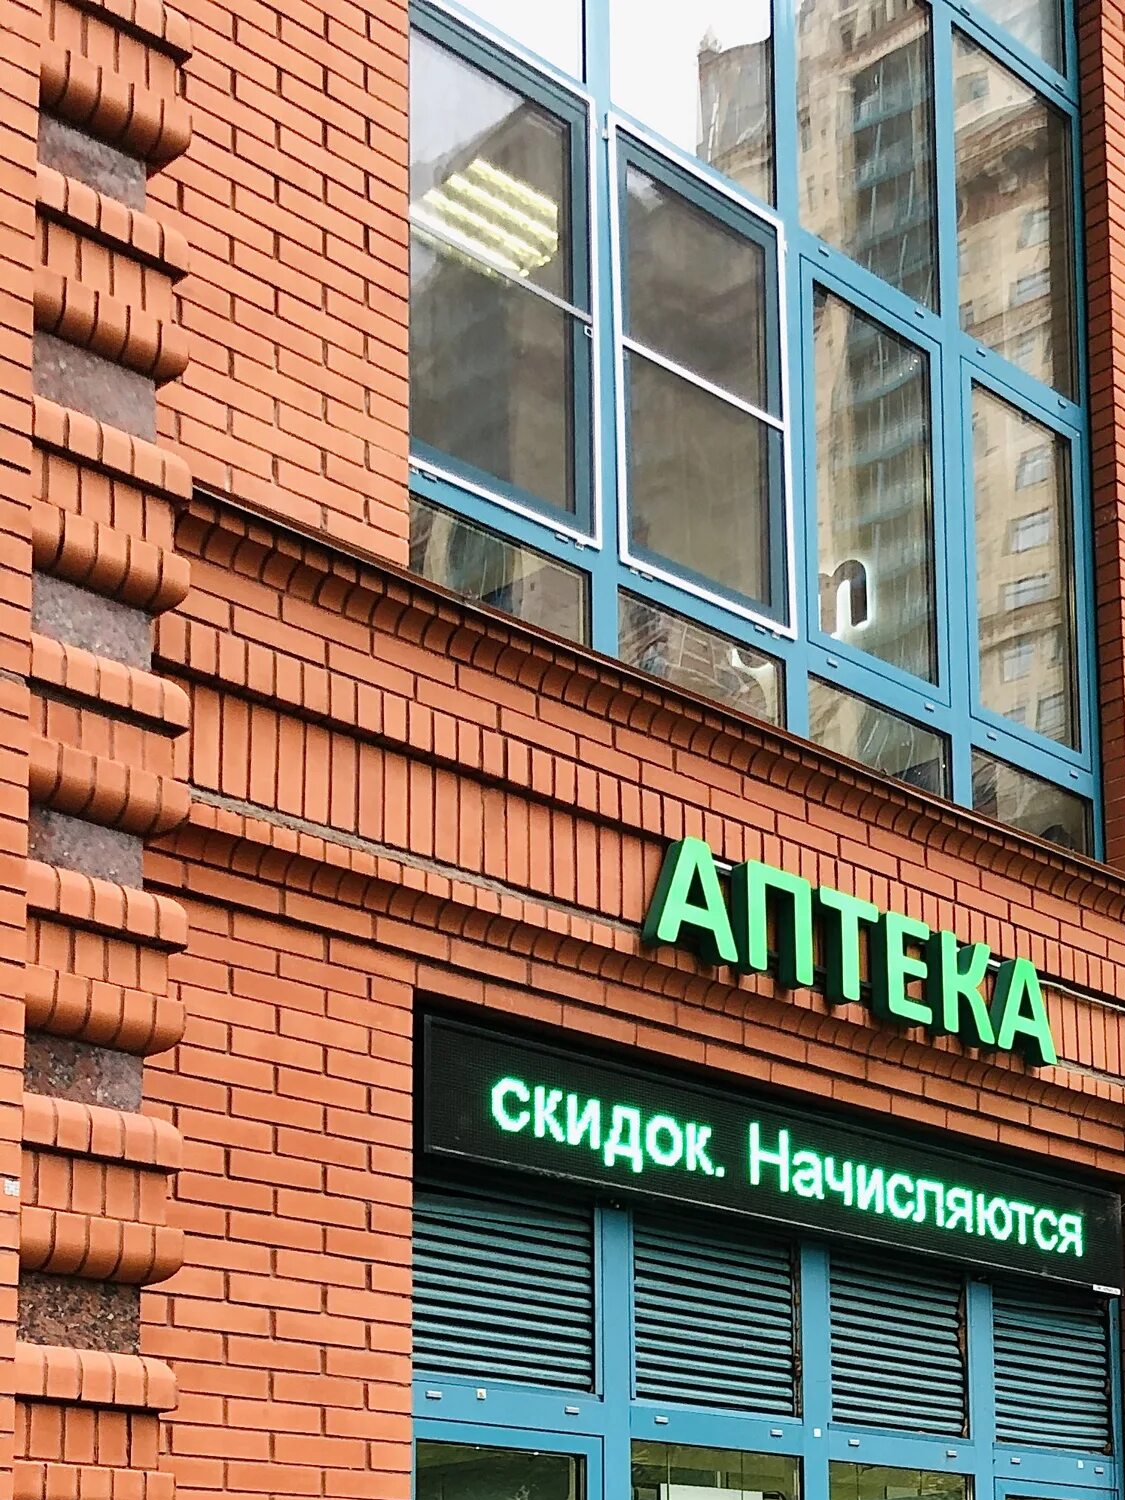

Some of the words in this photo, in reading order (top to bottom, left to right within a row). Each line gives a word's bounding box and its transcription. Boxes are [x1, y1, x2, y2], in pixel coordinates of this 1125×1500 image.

[645, 836, 1058, 1067] АПТЕКА
[491, 1076, 727, 1179] скидок.
[748, 1121, 1085, 1257] Начисляются
